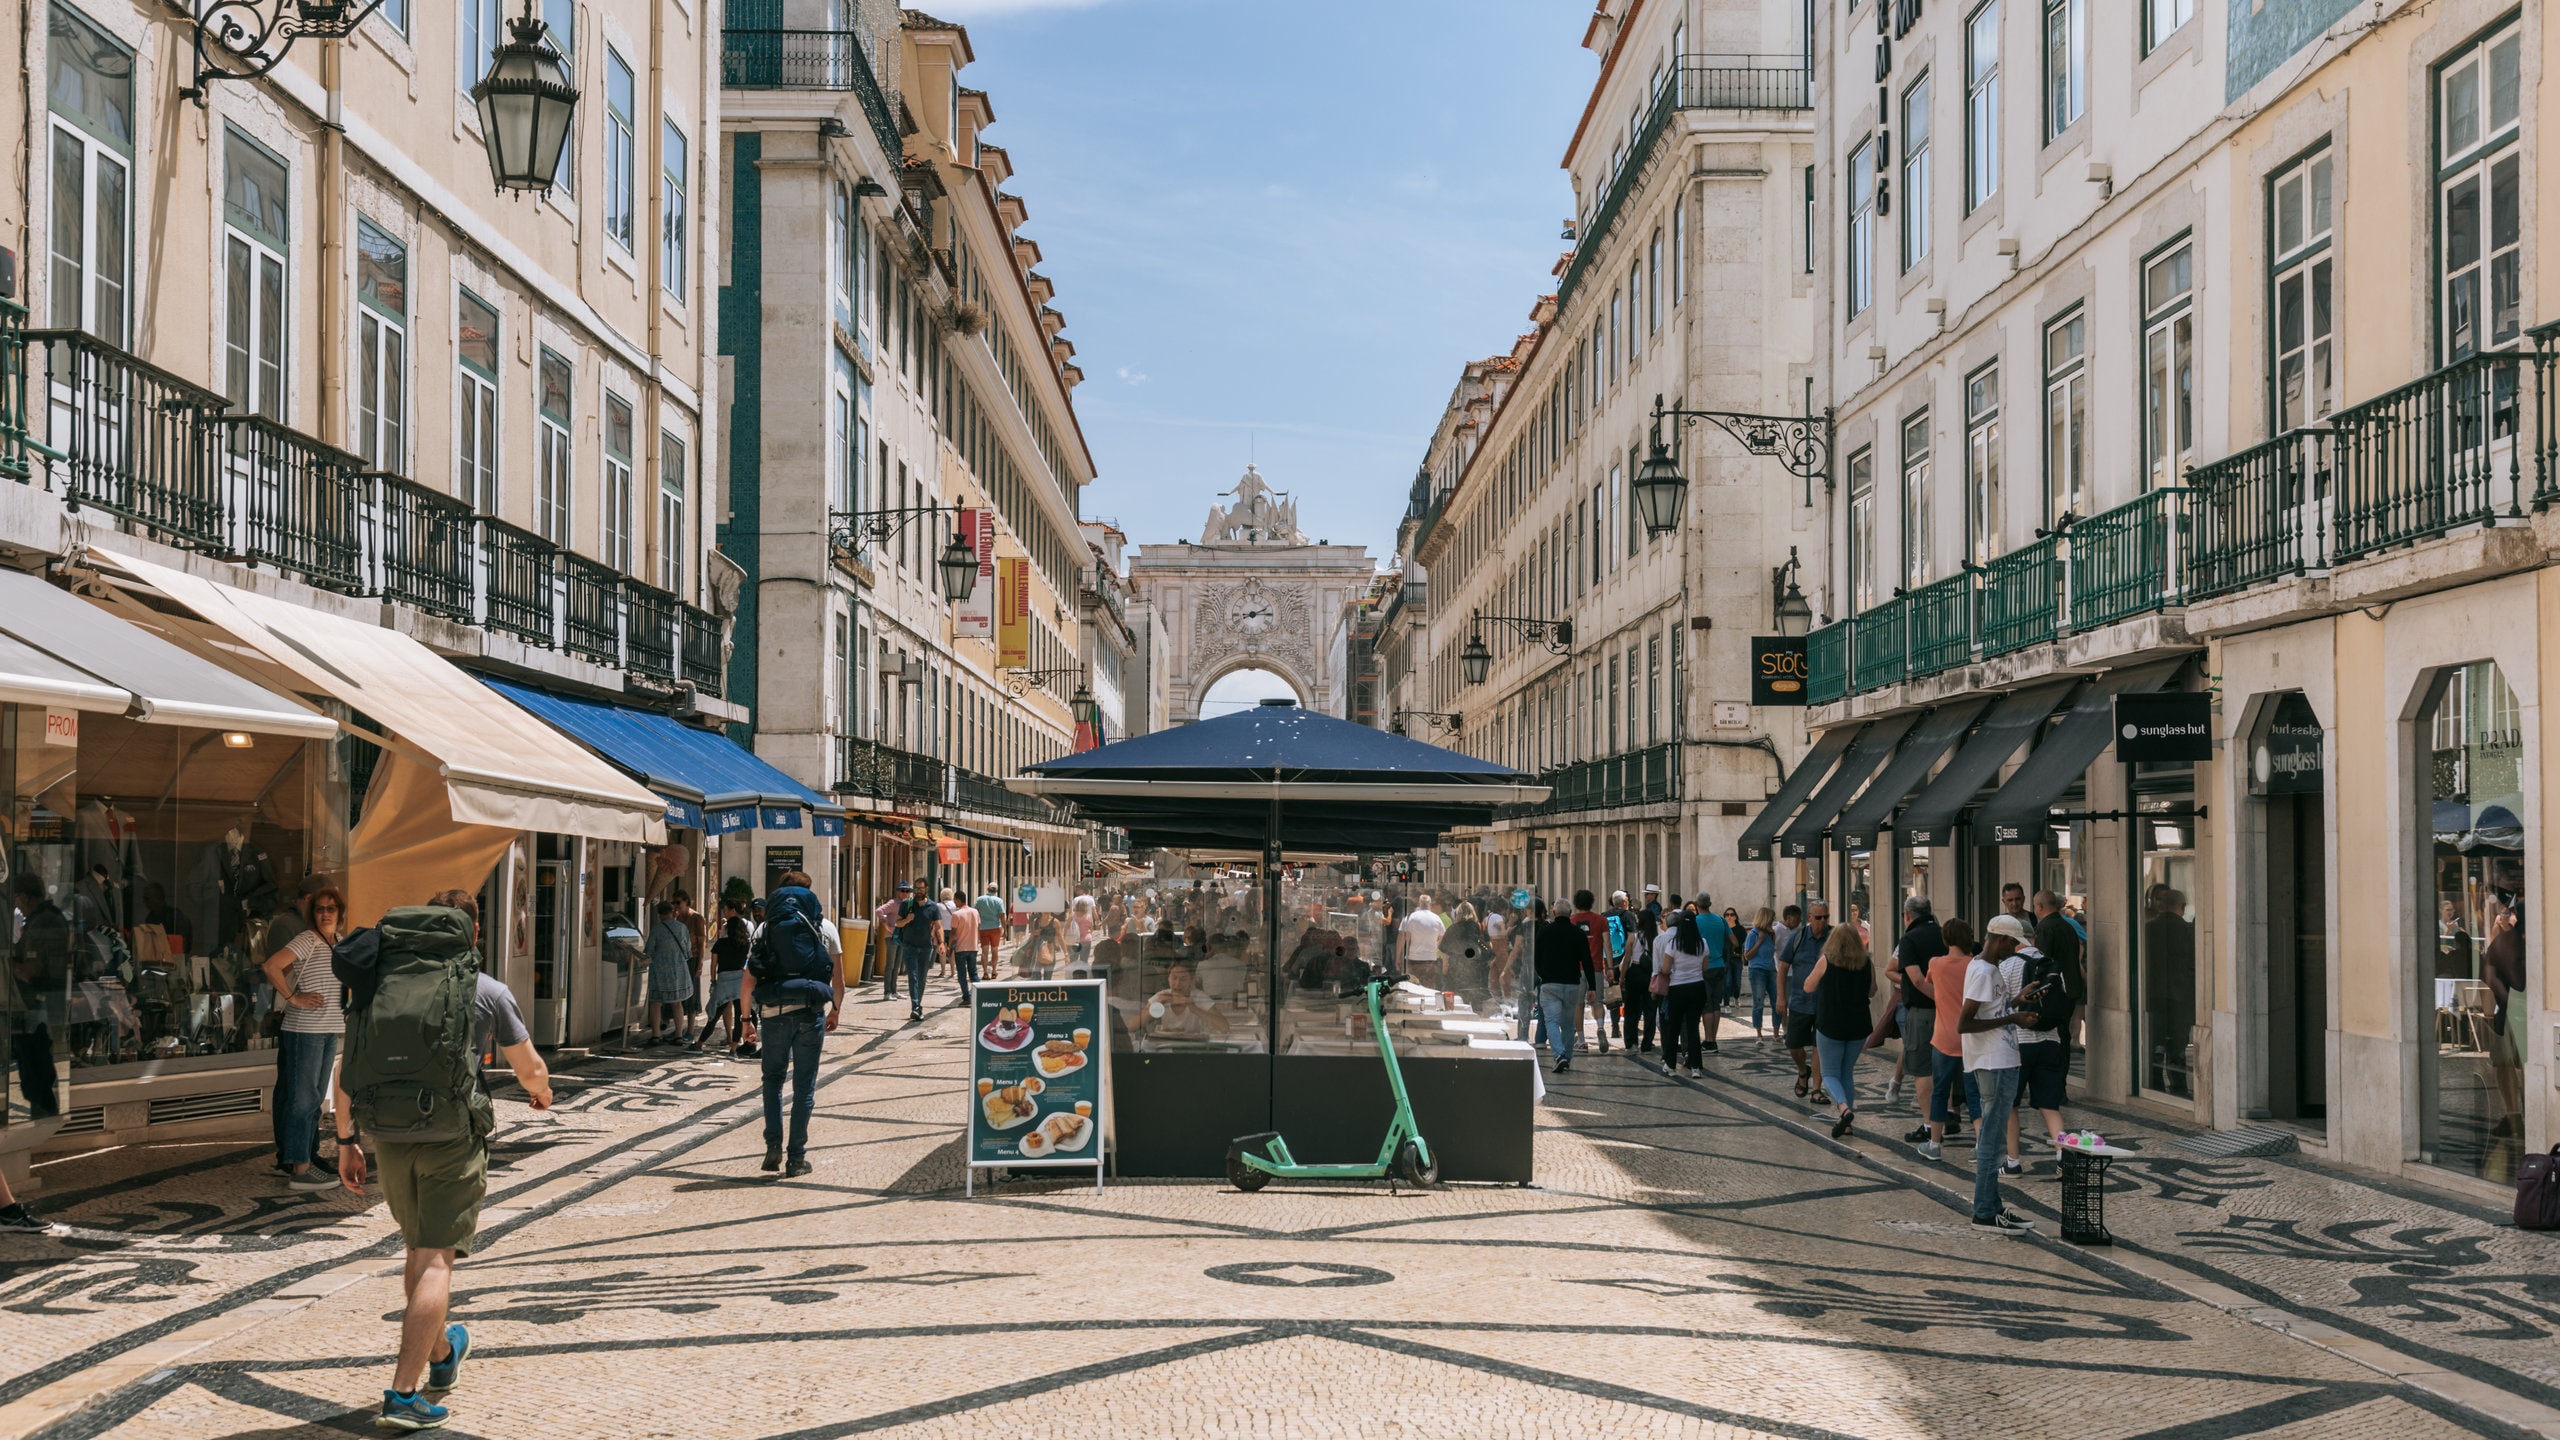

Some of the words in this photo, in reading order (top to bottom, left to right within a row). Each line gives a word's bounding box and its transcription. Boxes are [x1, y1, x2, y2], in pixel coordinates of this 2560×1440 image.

[979, 512, 992, 577] MILLENNIUM
[1018, 561, 1028, 617] MILLENNIUM
[2140, 724, 2186, 738] sunglass
[2187, 723, 2206, 735] hut
[2480, 728, 2523, 751] PRAD
[2272, 744, 2316, 780] sunglass
[1007, 986, 1069, 1003] Brunch
